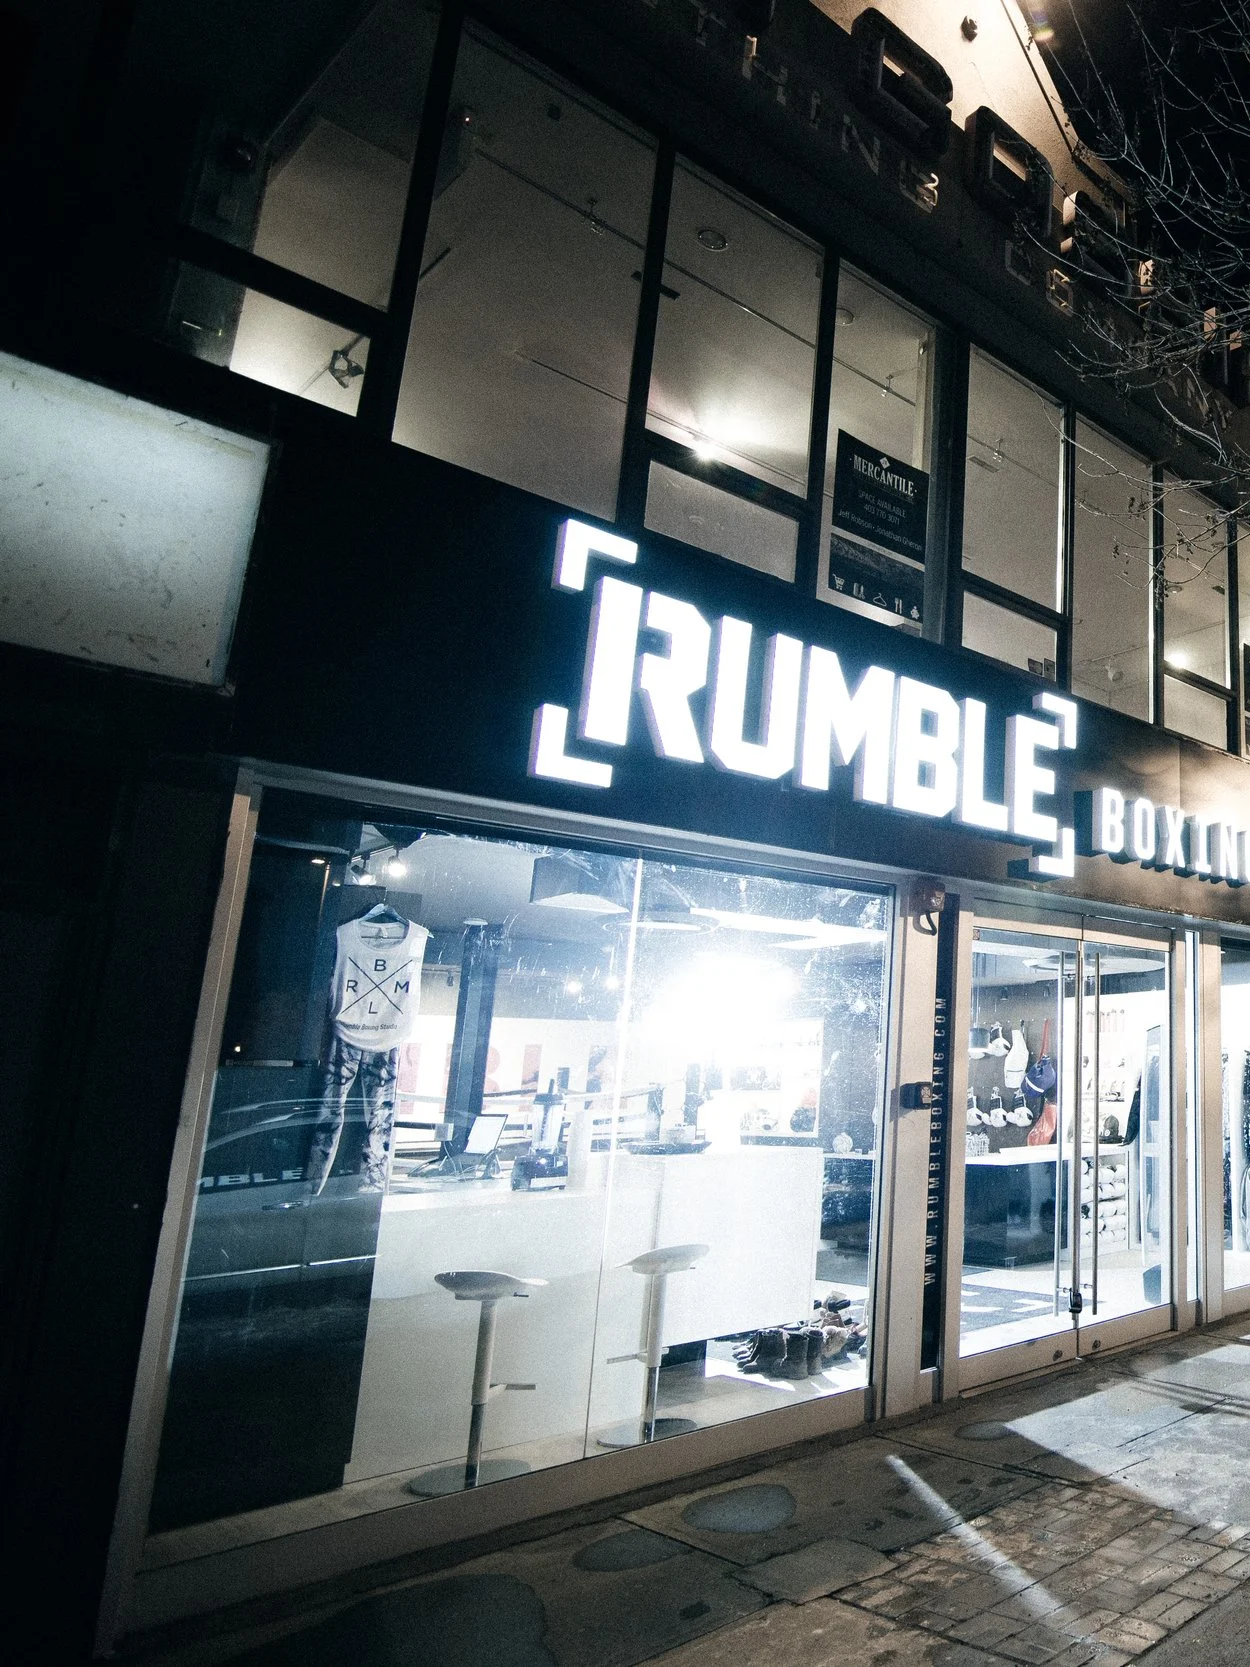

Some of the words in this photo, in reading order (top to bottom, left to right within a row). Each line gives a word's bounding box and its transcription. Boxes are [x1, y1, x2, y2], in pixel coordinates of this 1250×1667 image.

[854, 455, 915, 497] MERCANTILE
[858, 489, 876, 503] SPACE
[877, 499, 907, 518] AVAILABLE
[579, 576, 1060, 842] RUMBLE
[374, 959, 387, 972] B
[924, 997, 947, 1285] WWW.RUMBLEBOXING.COM
